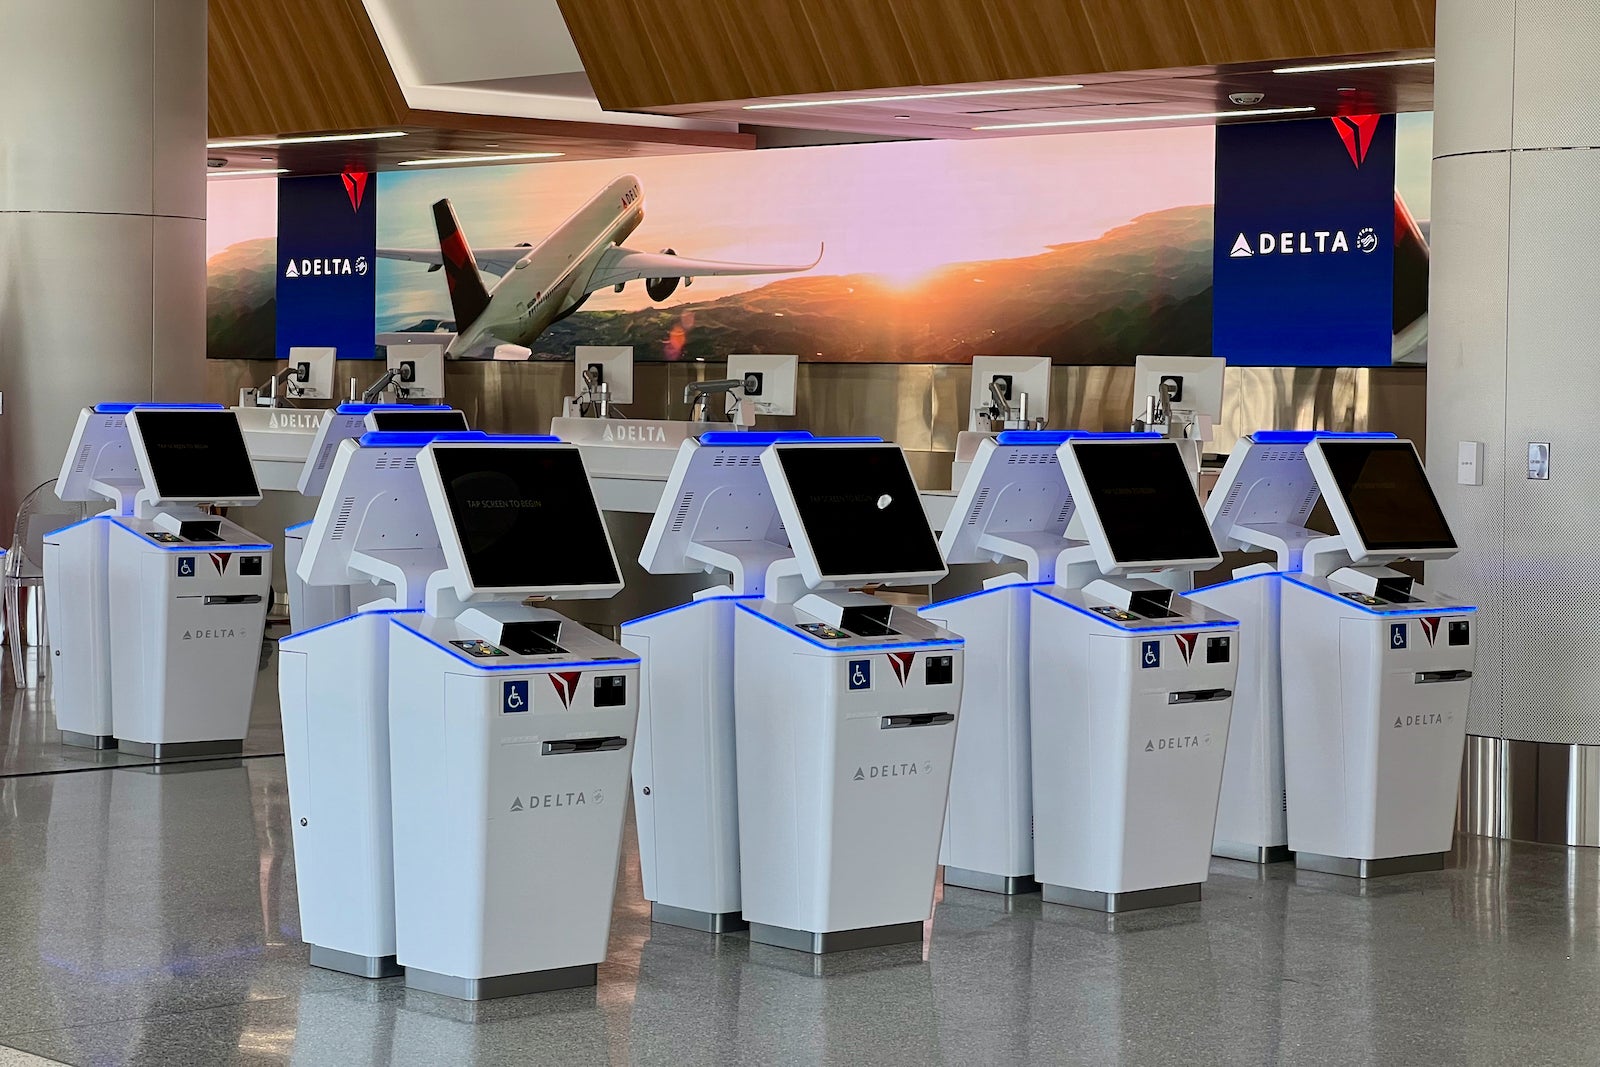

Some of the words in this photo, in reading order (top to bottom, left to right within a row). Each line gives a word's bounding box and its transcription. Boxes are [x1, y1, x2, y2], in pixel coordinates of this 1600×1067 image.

[1260, 231, 1348, 254] DELTA
[302, 258, 352, 275] DELTA
[281, 414, 321, 428] DELTA
[617, 425, 665, 442] DELTA
[467, 500, 480, 508] TAP
[509, 500, 520, 508] TO
[521, 500, 542, 508] BEGIN
[196, 629, 235, 639] DELTA
[1406, 714, 1442, 727] DELTA
[1158, 736, 1199, 750] DELTA
[870, 763, 917, 778] DELTA
[530, 792, 586, 808] DELTA
